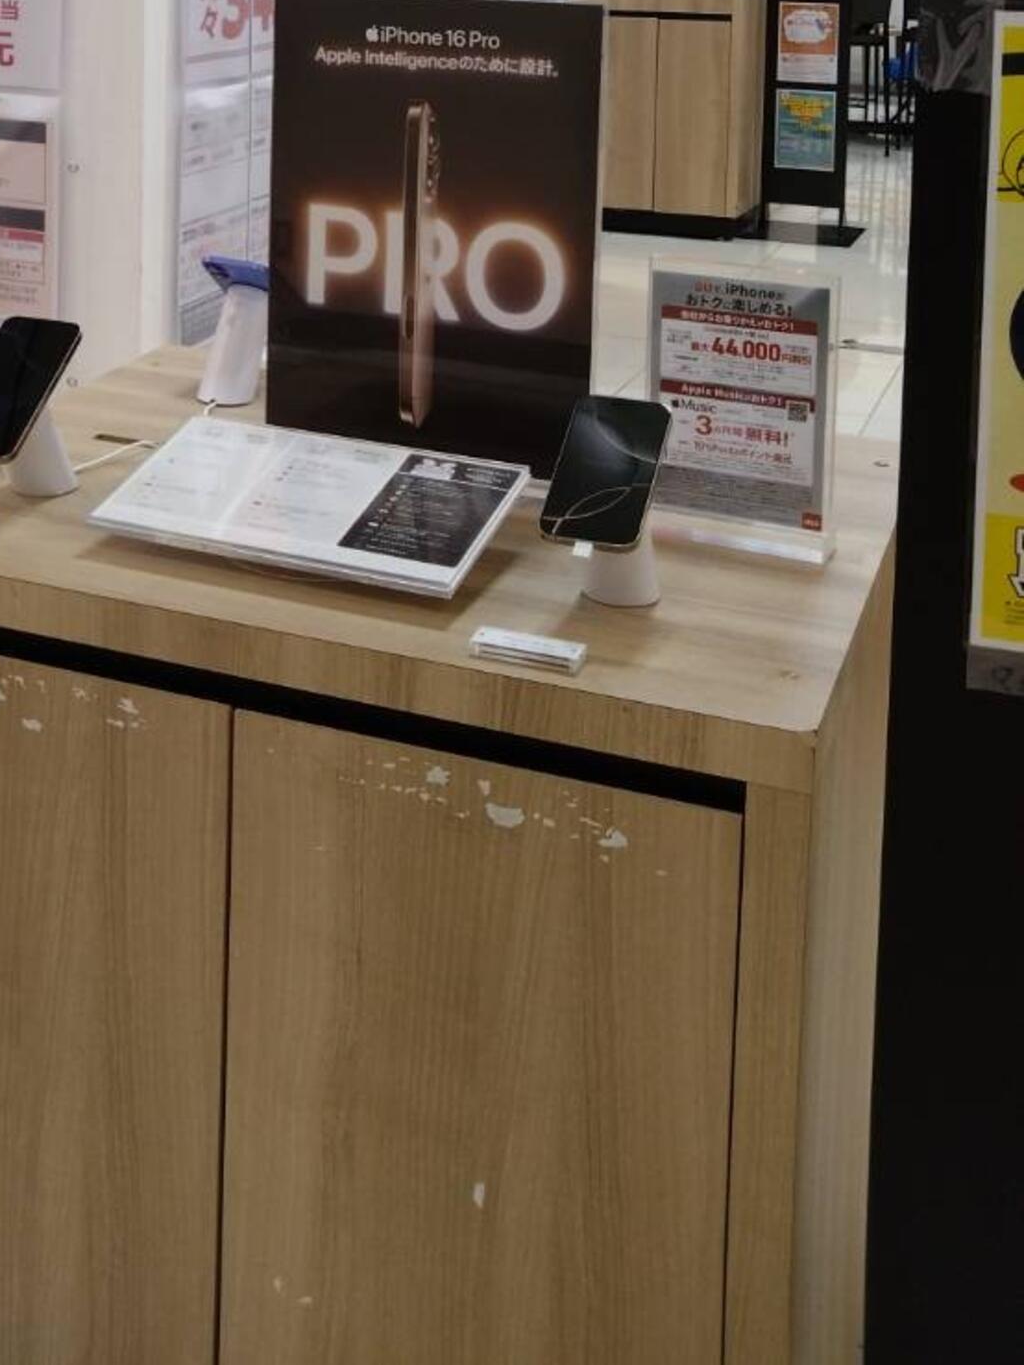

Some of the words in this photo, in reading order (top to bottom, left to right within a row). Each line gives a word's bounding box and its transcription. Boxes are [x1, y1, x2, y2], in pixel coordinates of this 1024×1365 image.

[381, 26, 442, 46] iPhone
[447, 30, 466, 47] 16
[469, 32, 501, 50] Pro
[314, 46, 362, 66] Apple
[365, 49, 559, 77] Intelligenceのために設計。
[306, 202, 566, 332] PRO
[681, 399, 718, 413] Music
